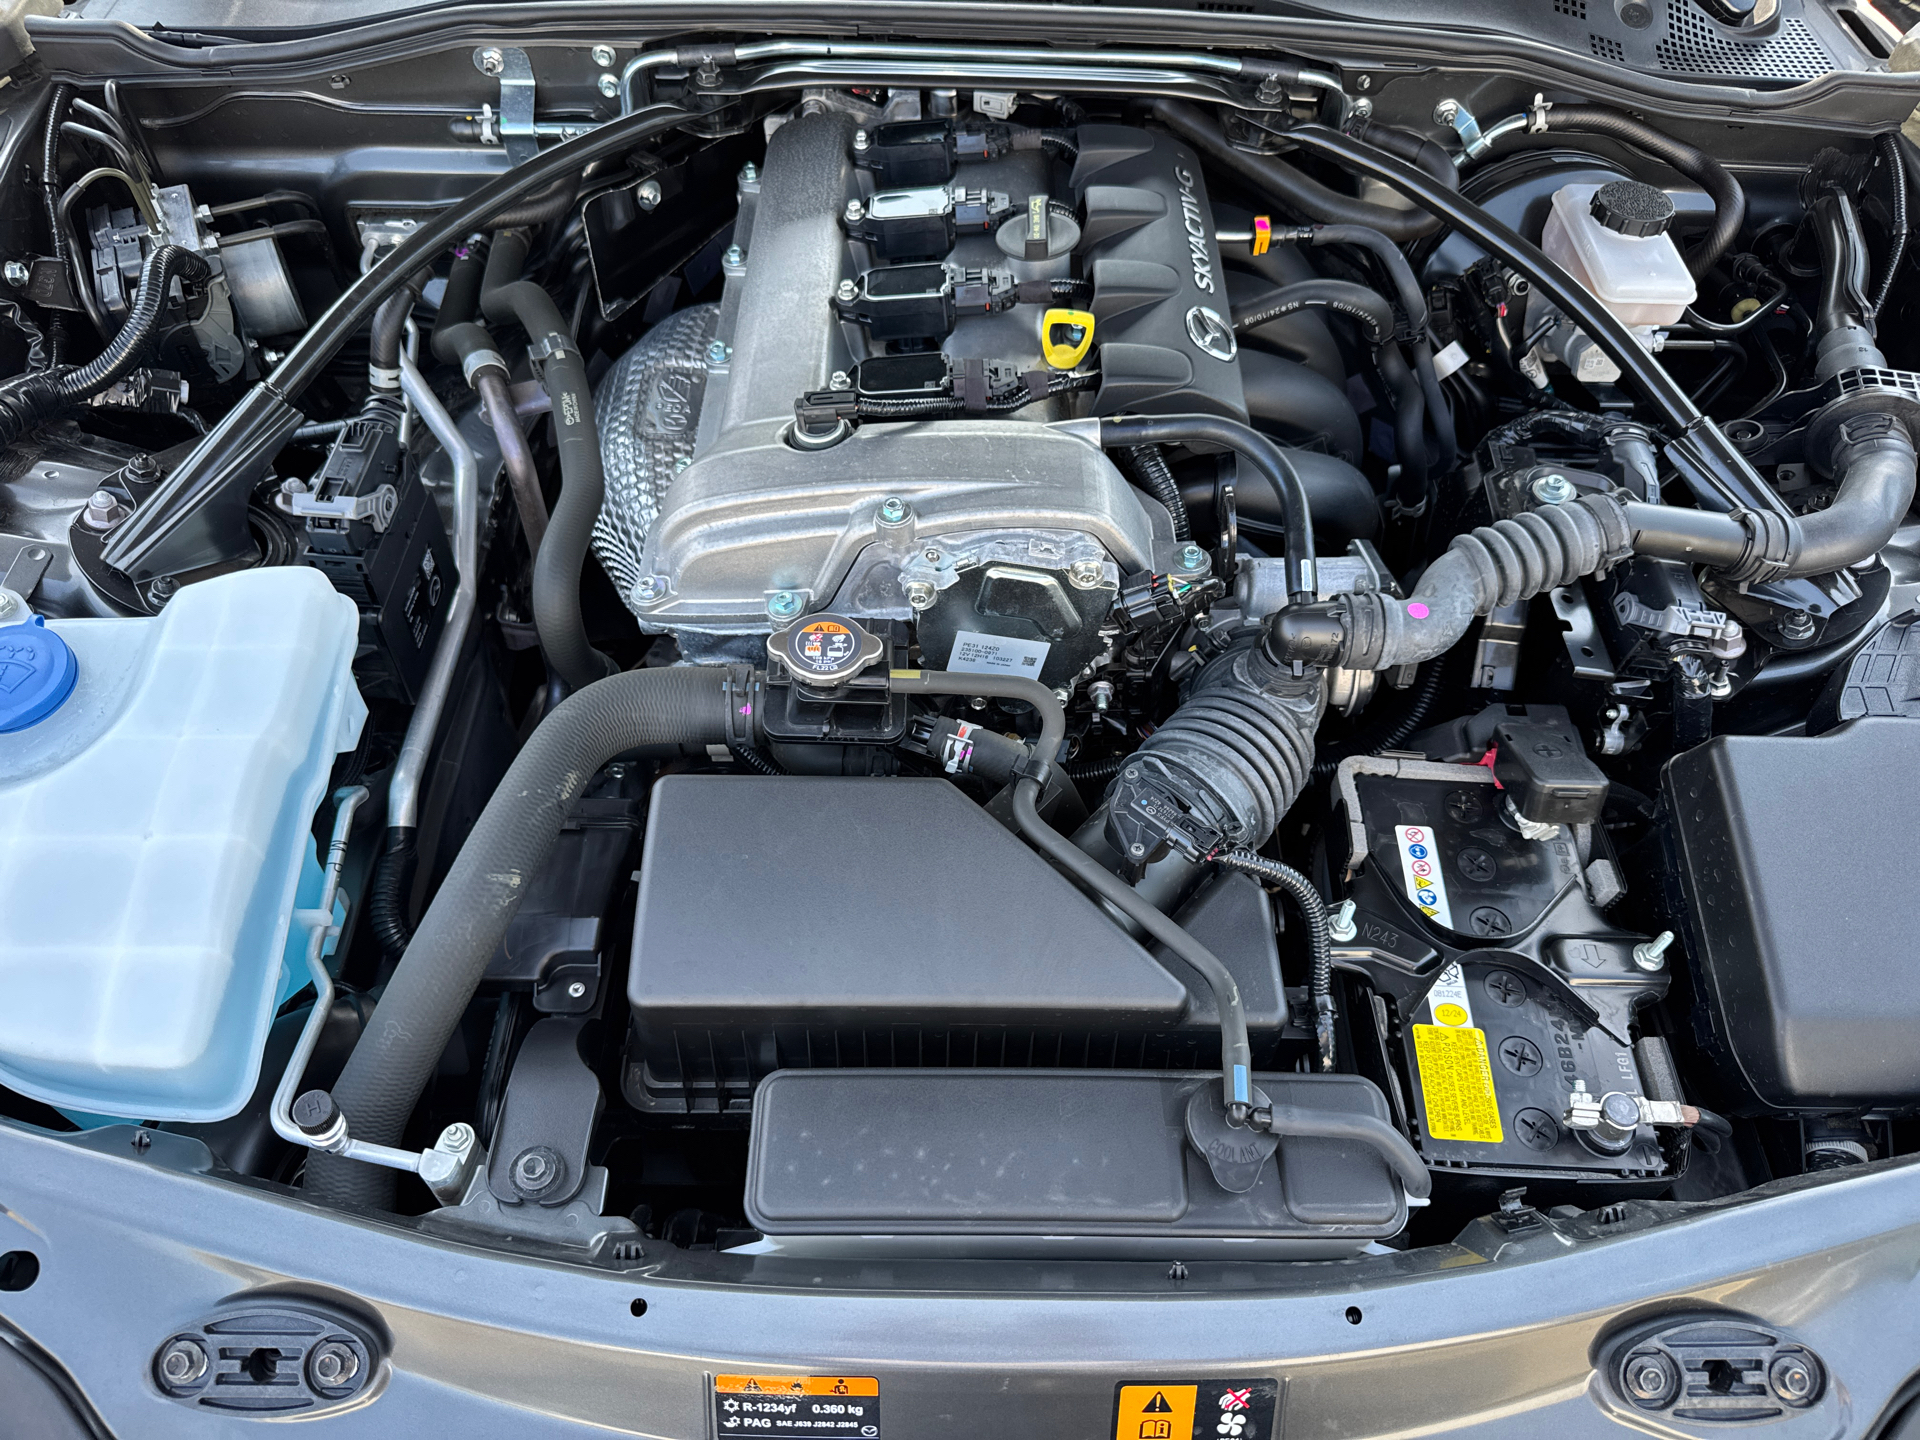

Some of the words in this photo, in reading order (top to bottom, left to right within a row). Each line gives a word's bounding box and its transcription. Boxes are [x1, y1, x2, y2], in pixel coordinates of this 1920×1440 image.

[1175, 166, 1215, 294] SKYACTIV-G
[1362, 922, 1399, 948] N243
[1442, 1009, 1462, 1017] 12/24
[1441, 1042, 1454, 1070] POISON
[1428, 1072, 1436, 1089] REACH
[1446, 1071, 1455, 1091] CAUSES
[1455, 1068, 1463, 1082] CAPS
[1457, 1083, 1466, 1097] TIGHT
[1475, 1047, 1490, 1081] DANGER
[1487, 1110, 1496, 1128] GASES
[1431, 1097, 1441, 1122] CHILDREN
[1449, 1092, 1459, 1112] SEVERE
[1453, 1113, 1462, 1130] BURNS
[1462, 1110, 1470, 1125] LEVEL
[1208, 1138, 1260, 1162] COOLANT
[742, 1402, 797, 1413] R-1234yf
[812, 1404, 845, 1414] 0.360
[847, 1404, 864, 1416] kg
[744, 1418, 772, 1427] PAG
